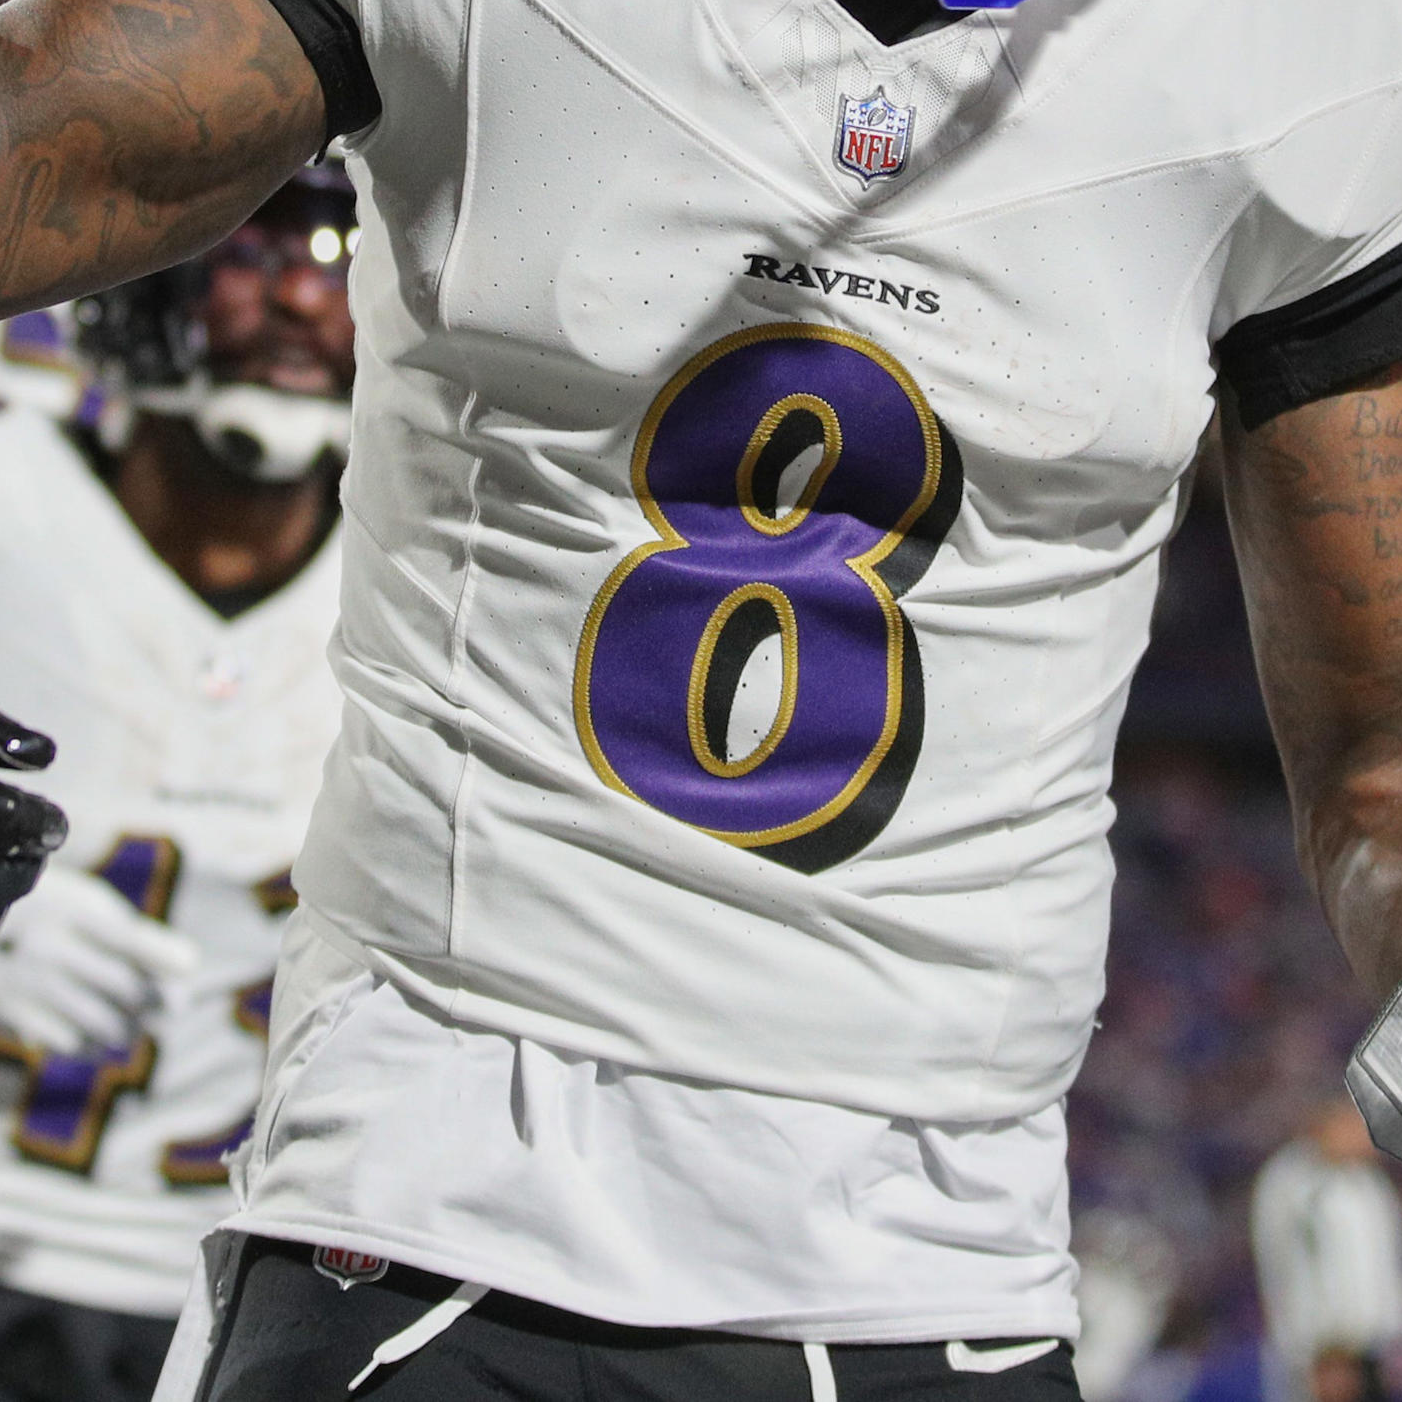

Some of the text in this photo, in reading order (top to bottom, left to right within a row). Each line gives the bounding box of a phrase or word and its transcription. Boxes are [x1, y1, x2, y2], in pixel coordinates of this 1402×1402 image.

[844, 129, 899, 172] NFL
[742, 253, 942, 315] RAVENS
[572, 320, 965, 877] 8
